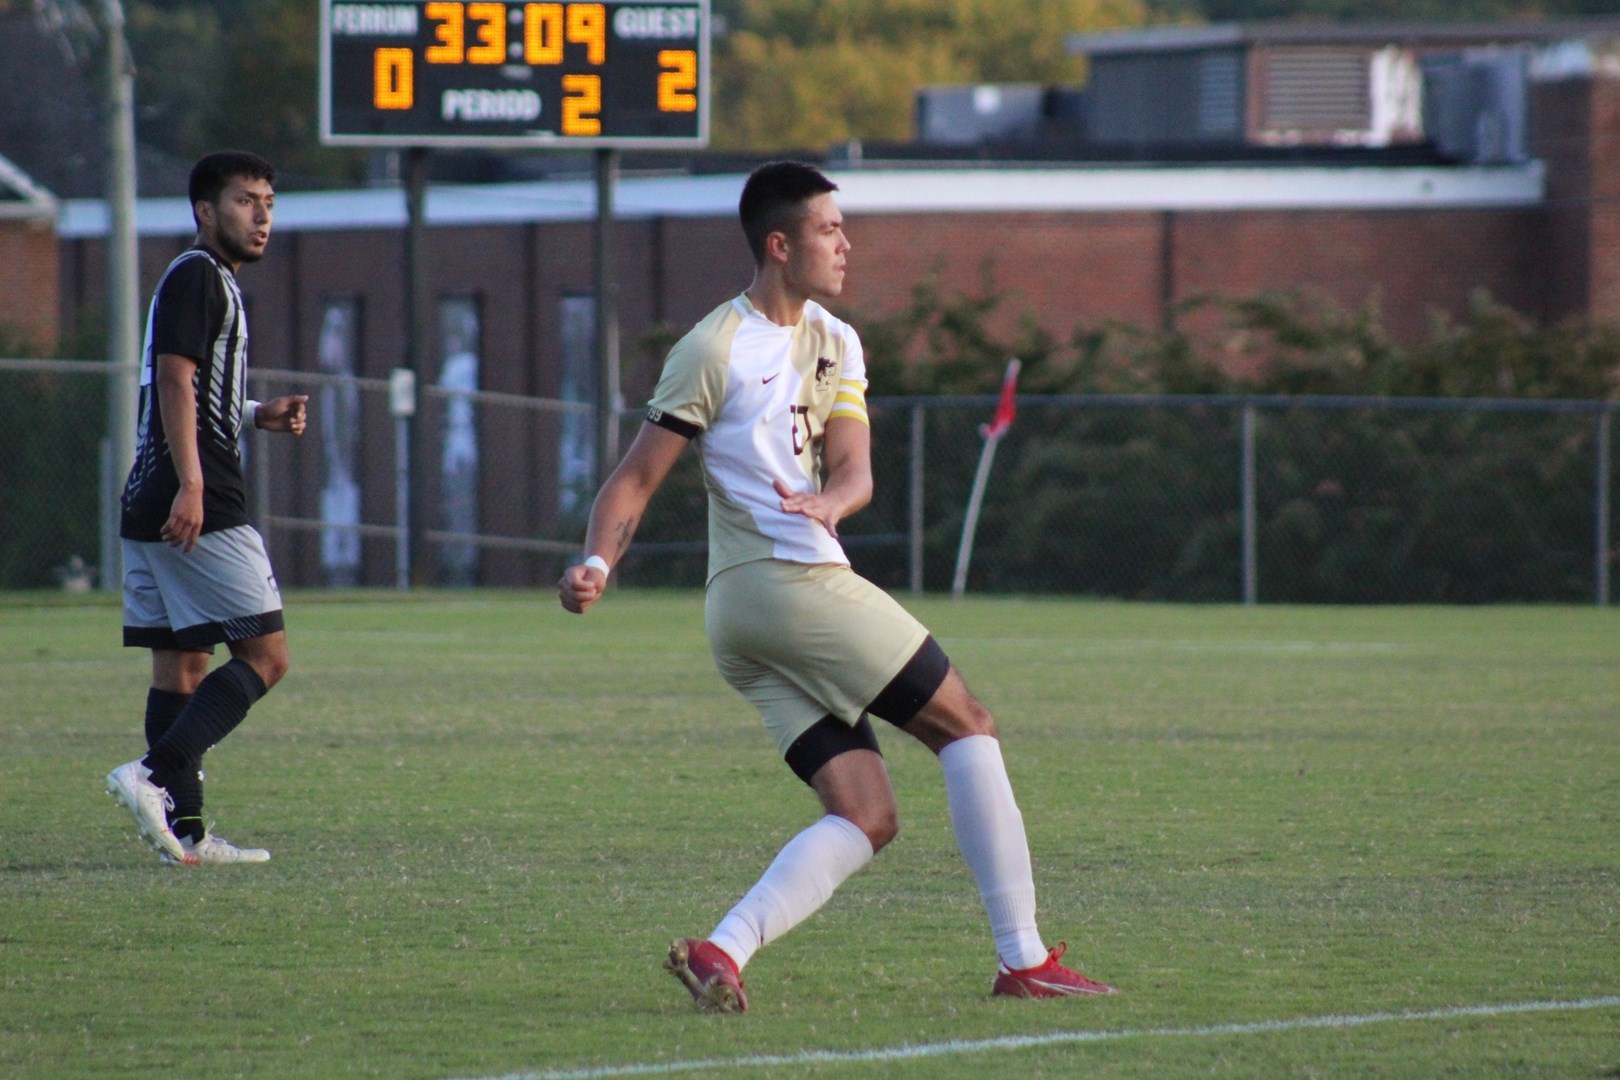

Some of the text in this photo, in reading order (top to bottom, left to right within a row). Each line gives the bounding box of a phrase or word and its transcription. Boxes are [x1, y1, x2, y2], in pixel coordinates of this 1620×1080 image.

[425, 2, 605, 65] 33:09
[613, 7, 697, 38] GUEST
[374, 47, 414, 110] 0
[442, 74, 602, 136] PERIOD 2
[657, 50, 697, 112] 2
